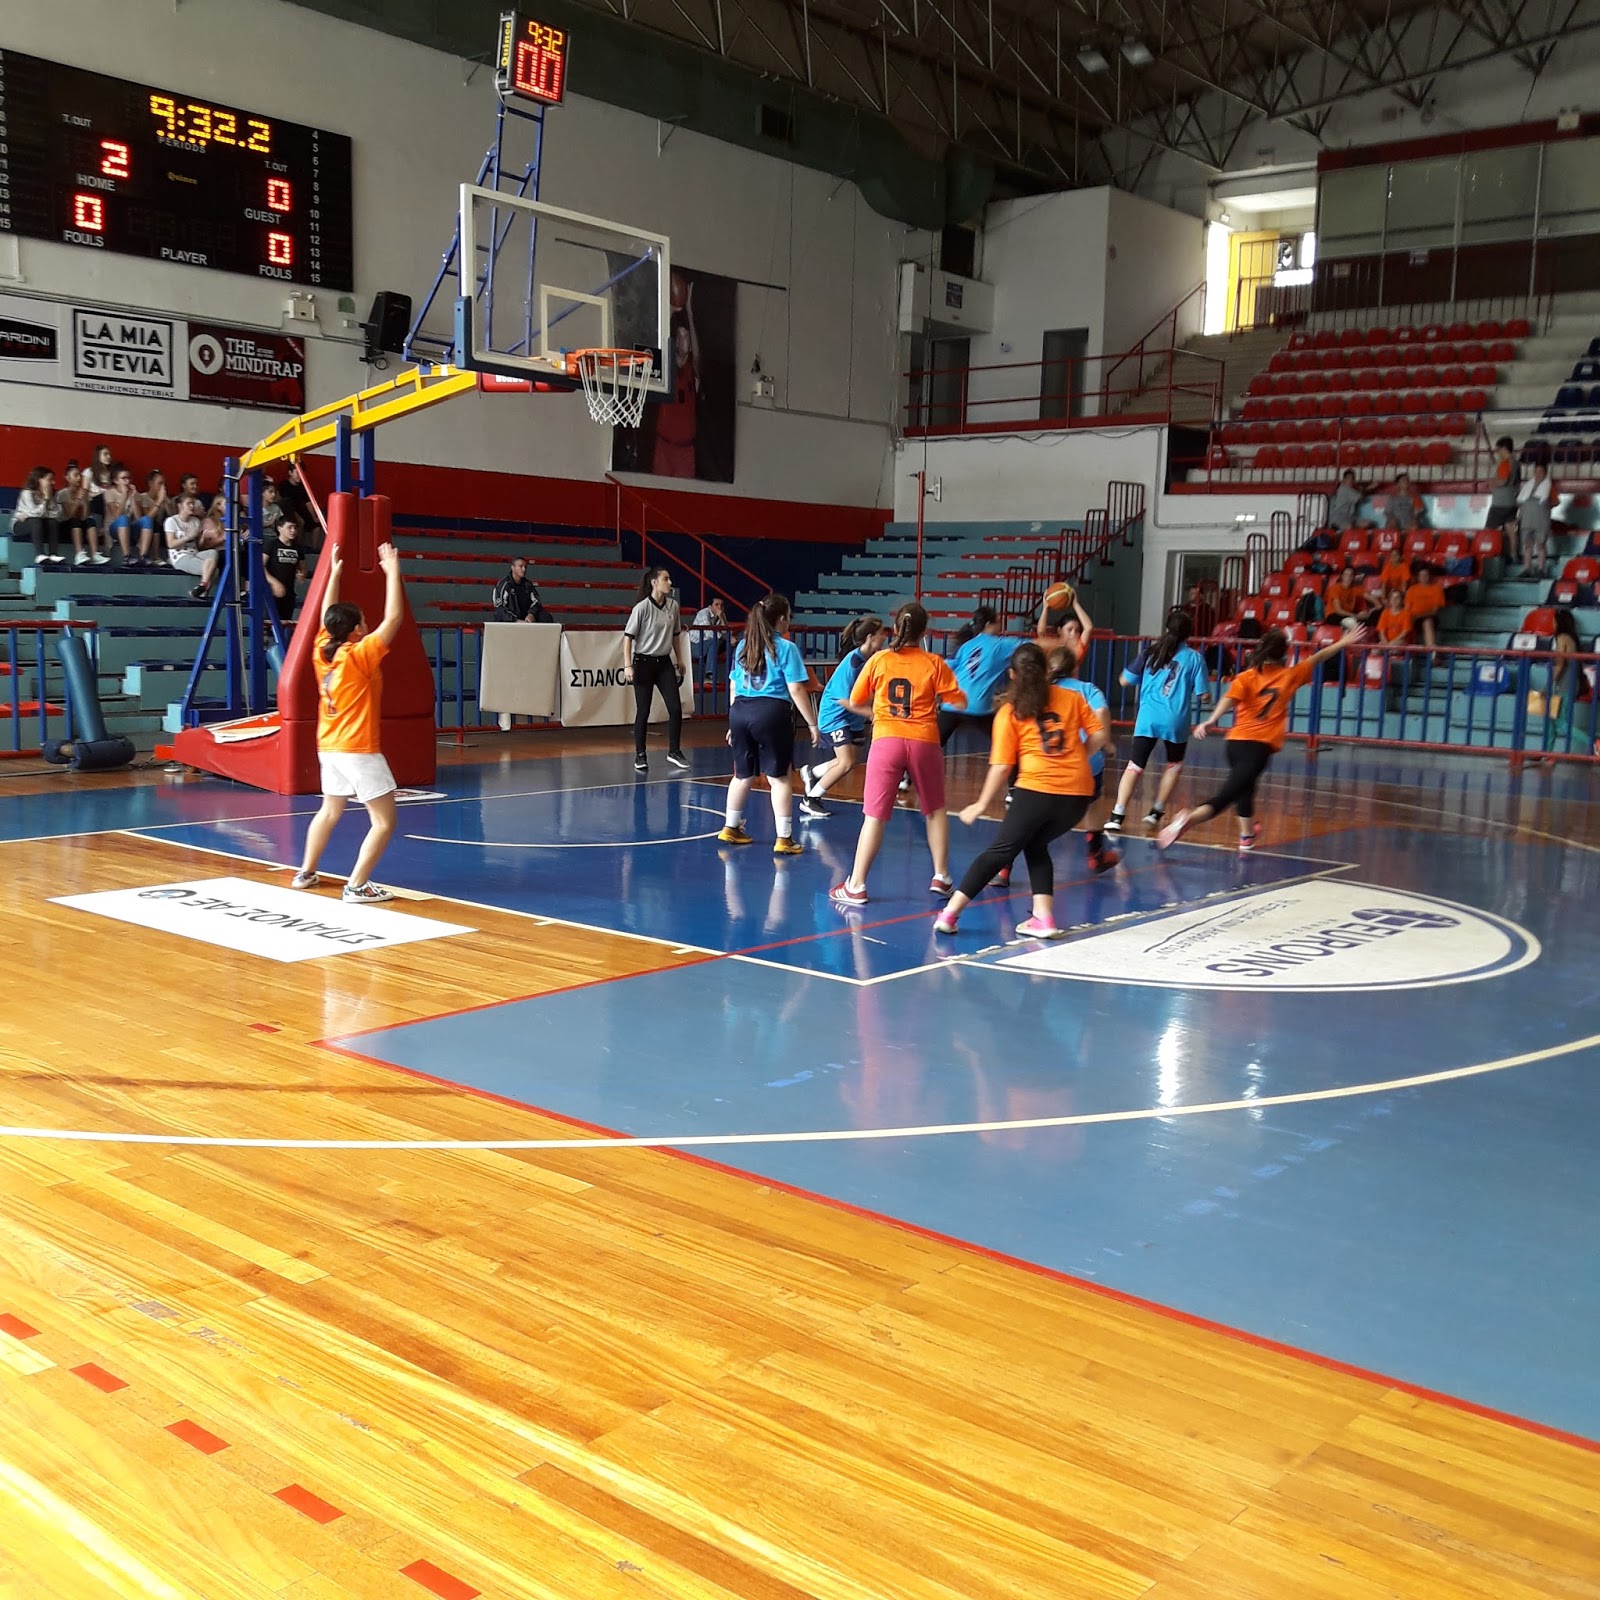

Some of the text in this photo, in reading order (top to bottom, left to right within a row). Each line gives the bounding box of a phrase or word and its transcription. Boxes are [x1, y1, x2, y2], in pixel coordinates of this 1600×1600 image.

[528, 21, 563, 55] 9:32
[150, 95, 270, 153] 9:32.2
[312, 131, 318, 140] 4
[157, 136, 206, 154] PERIODS
[312, 144, 319, 153] 5
[101, 141, 128, 177] 2
[312, 157, 319, 165] 6
[77, 173, 116, 191] HOME
[313, 169, 319, 178] 7
[268, 179, 290, 211] 0
[313, 182, 320, 191] 8
[313, 195, 320, 204] 9
[75, 195, 102, 230] 0
[244, 208, 281, 224] GUEST
[310, 209, 320, 219] 10
[310, 222, 320, 232] 11
[64, 230, 104, 247] FOULS
[310, 235, 320, 245] 12
[161, 247, 207, 265] PLAYER
[268, 232, 290, 264] 0
[310, 248, 320, 258] 13
[259, 265, 292, 280] FOULS
[310, 261, 320, 270] 14
[310, 274, 321, 283] 15
[82, 319, 163, 348] LA MIA
[225, 337, 256, 356] THE
[82, 349, 165, 377] STEVIA
[225, 354, 303, 379] MINDTRAP
[887, 677, 912, 719] 9
[829, 729, 846, 743] 12
[224, 908, 387, 945] ΣΠΑΝΟΣ
[1205, 922, 1405, 977] EUROINS
